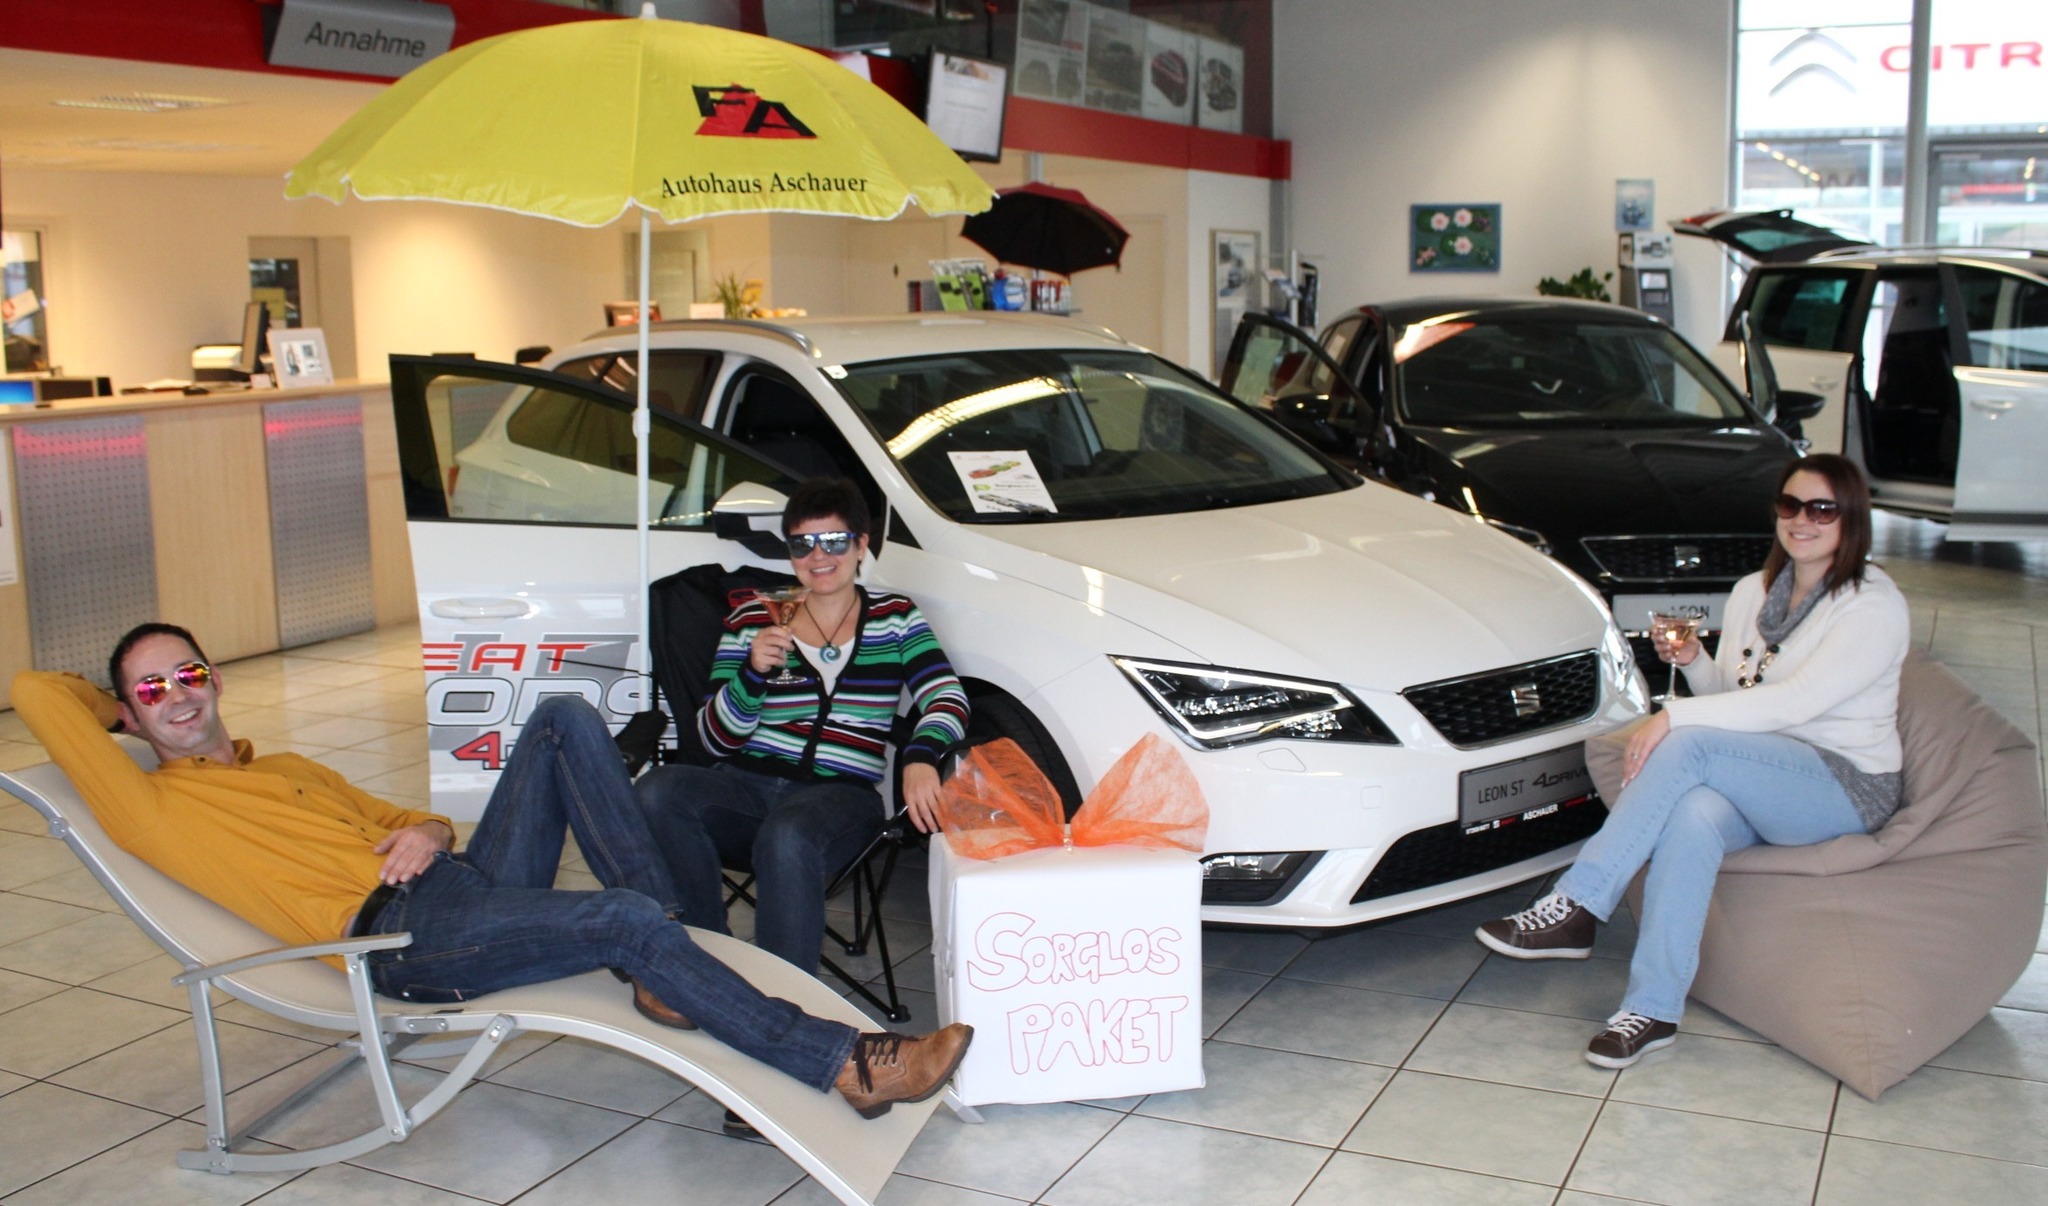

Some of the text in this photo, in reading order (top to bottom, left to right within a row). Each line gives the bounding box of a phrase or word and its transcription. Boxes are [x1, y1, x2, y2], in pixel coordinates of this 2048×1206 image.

[304, 20, 427, 58] Annahme
[691, 83, 818, 139] FA
[661, 172, 868, 199] Autohaus Aschauer
[1669, 605, 1710, 620] ON
[1478, 785, 1508, 804] LEON
[1511, 779, 1525, 797] ST
[1522, 803, 1559, 822] ASCHAUER
[967, 911, 1183, 992] SORGLOS
[1006, 996, 1189, 1076] PAKET
